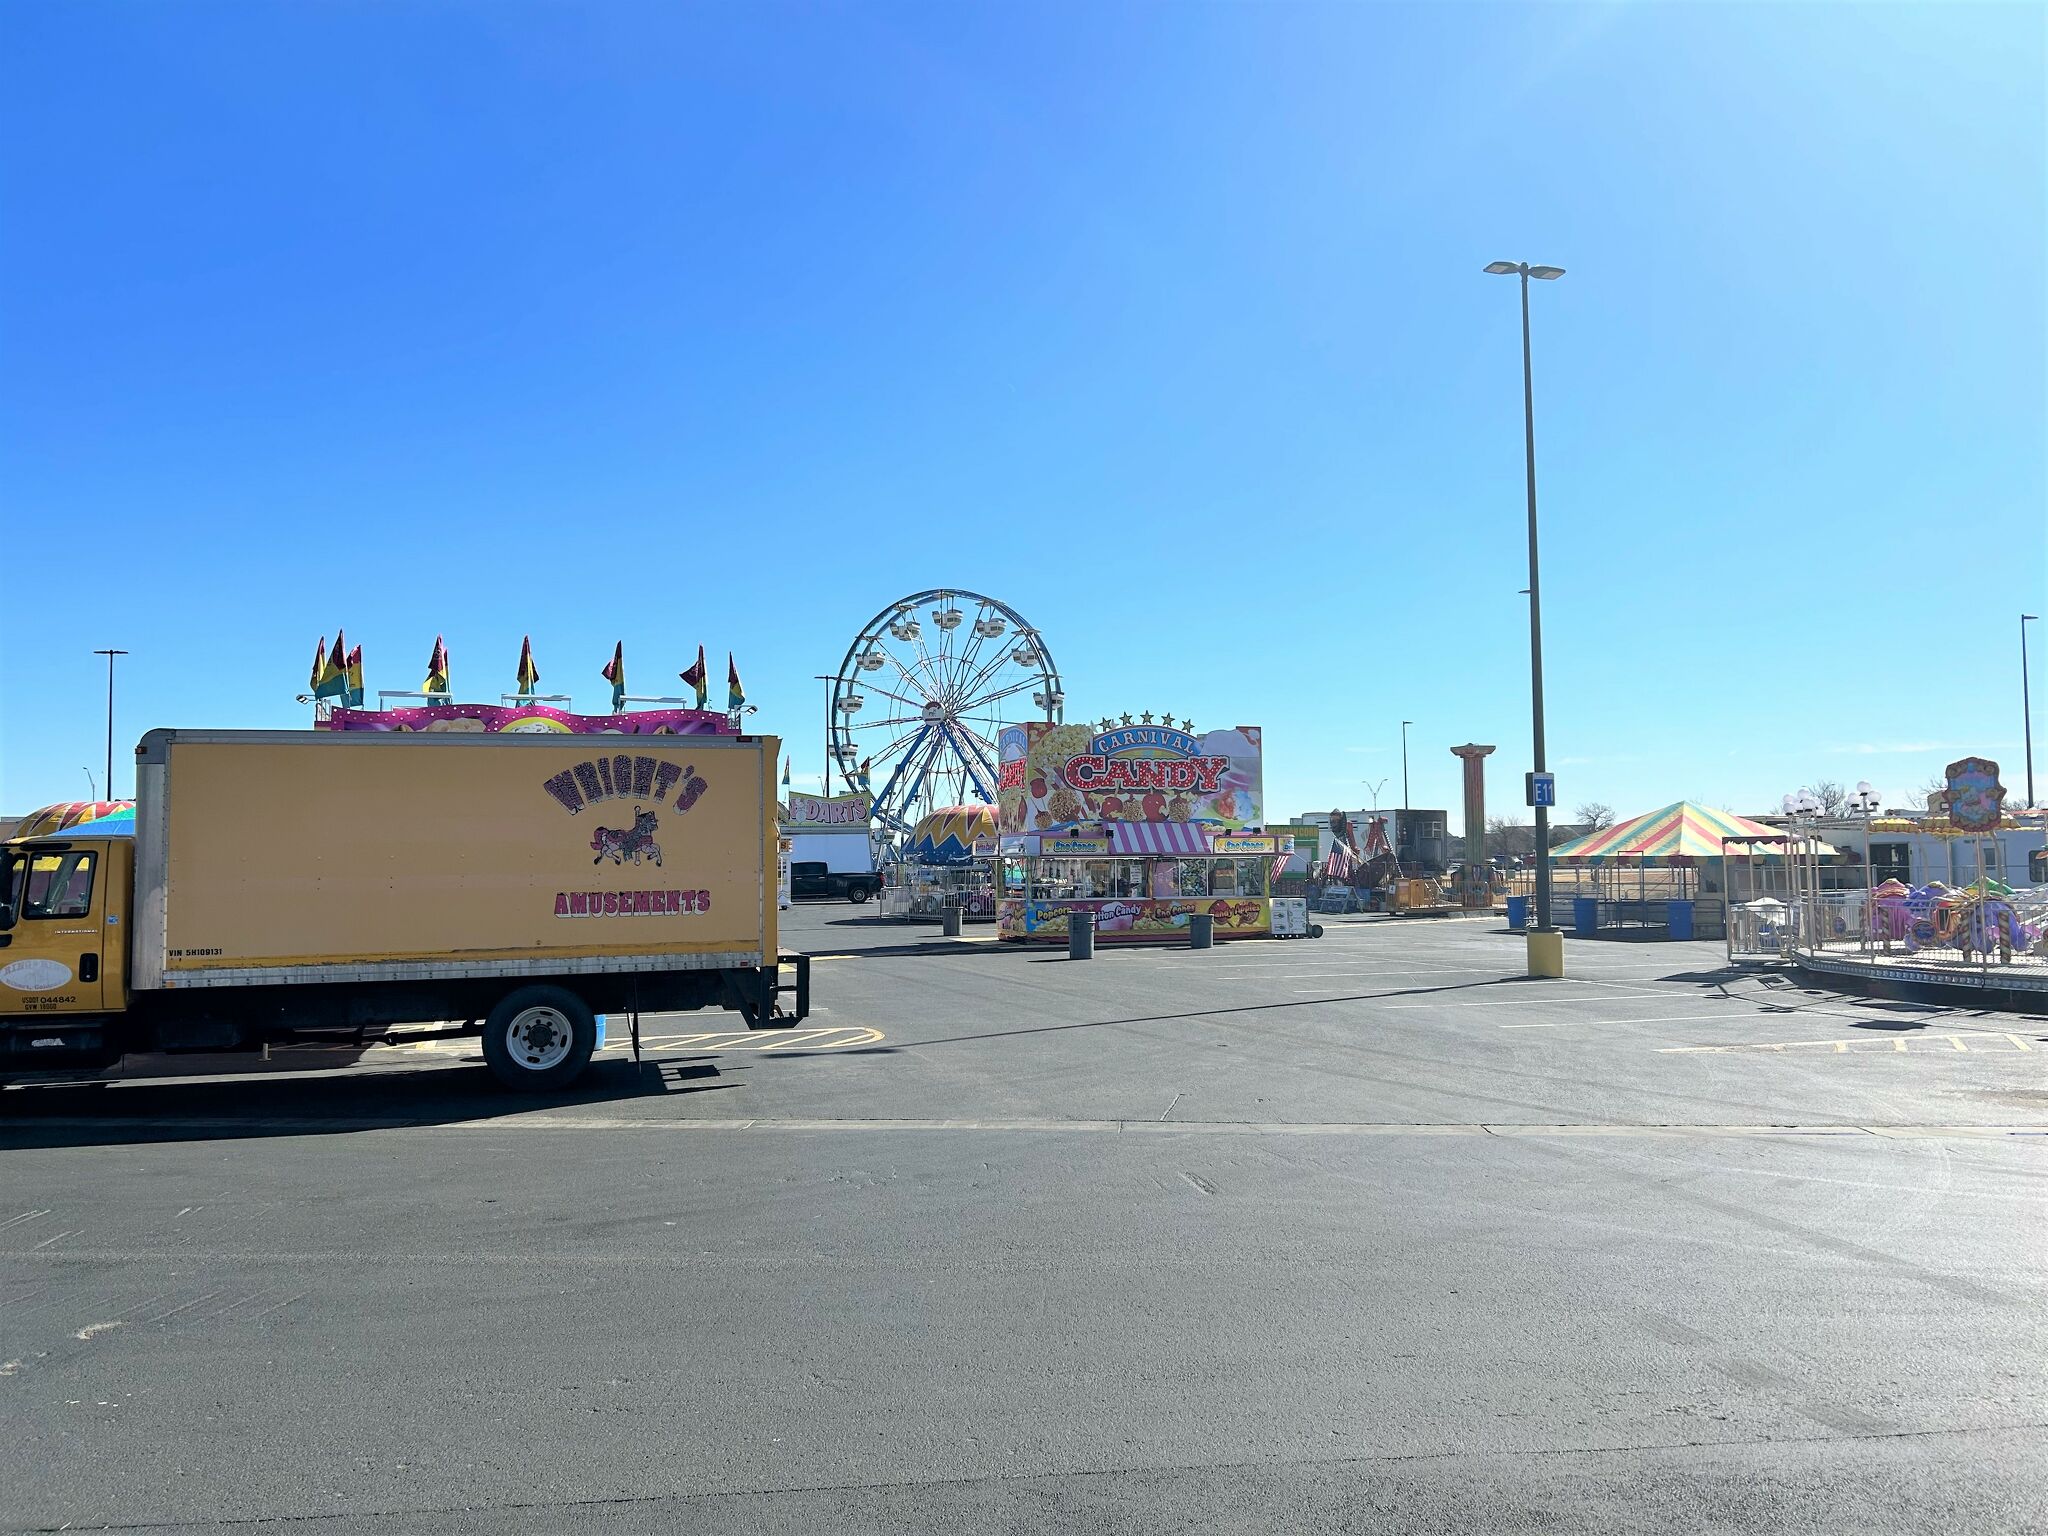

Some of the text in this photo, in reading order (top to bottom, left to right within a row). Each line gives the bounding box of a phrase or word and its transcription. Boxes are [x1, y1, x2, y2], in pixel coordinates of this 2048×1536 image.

[1099, 731, 1194, 753] CARNIVAL
[543, 755, 708, 816] WRIGHT'S
[1064, 754, 1229, 792] CANDY
[1535, 783, 1553, 802] E11
[806, 798, 867, 823] DARTS
[554, 890, 711, 918] AMUSEMENTS
[1115, 904, 1142, 917] Candy
